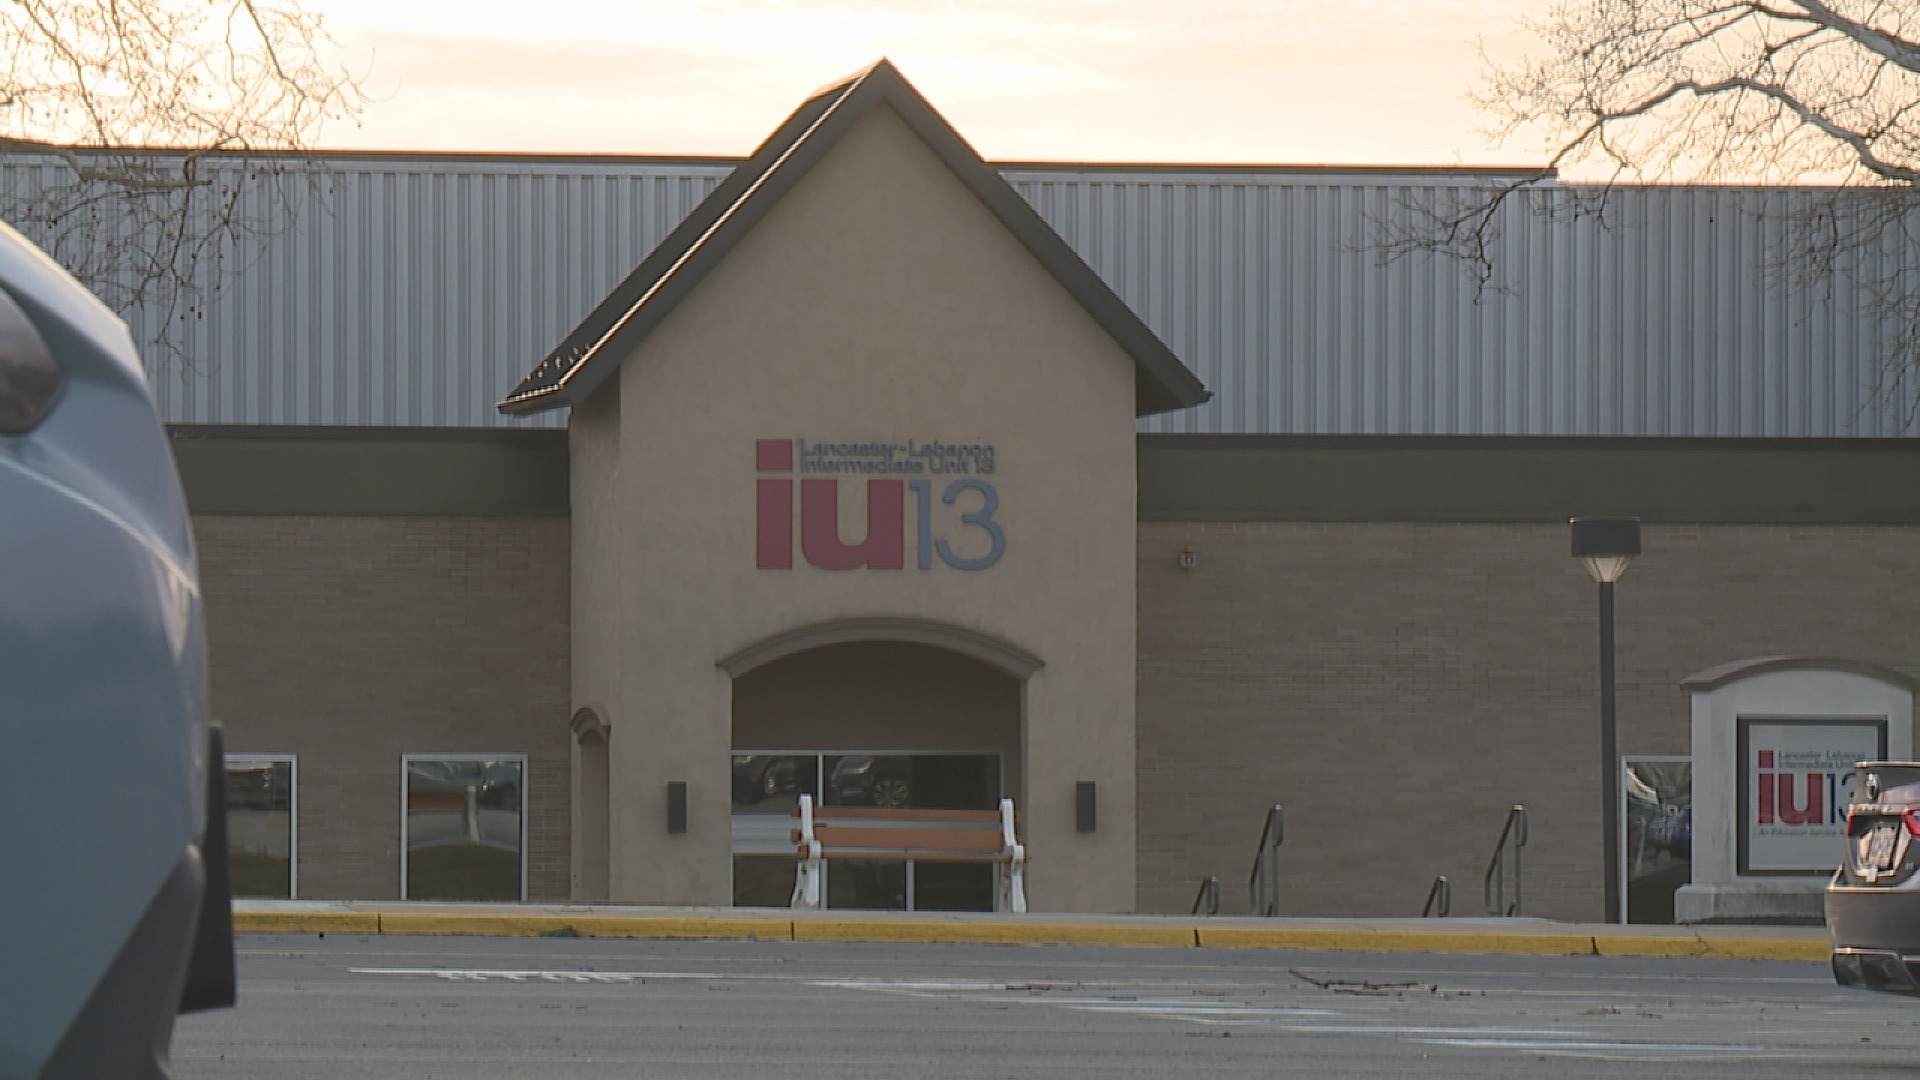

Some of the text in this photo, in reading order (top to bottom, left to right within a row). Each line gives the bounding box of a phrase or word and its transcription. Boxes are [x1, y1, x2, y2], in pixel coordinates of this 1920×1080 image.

[801, 438, 994, 456] Lancaster-Lebanon
[801, 457, 994, 473] Intermediate Unit 13
